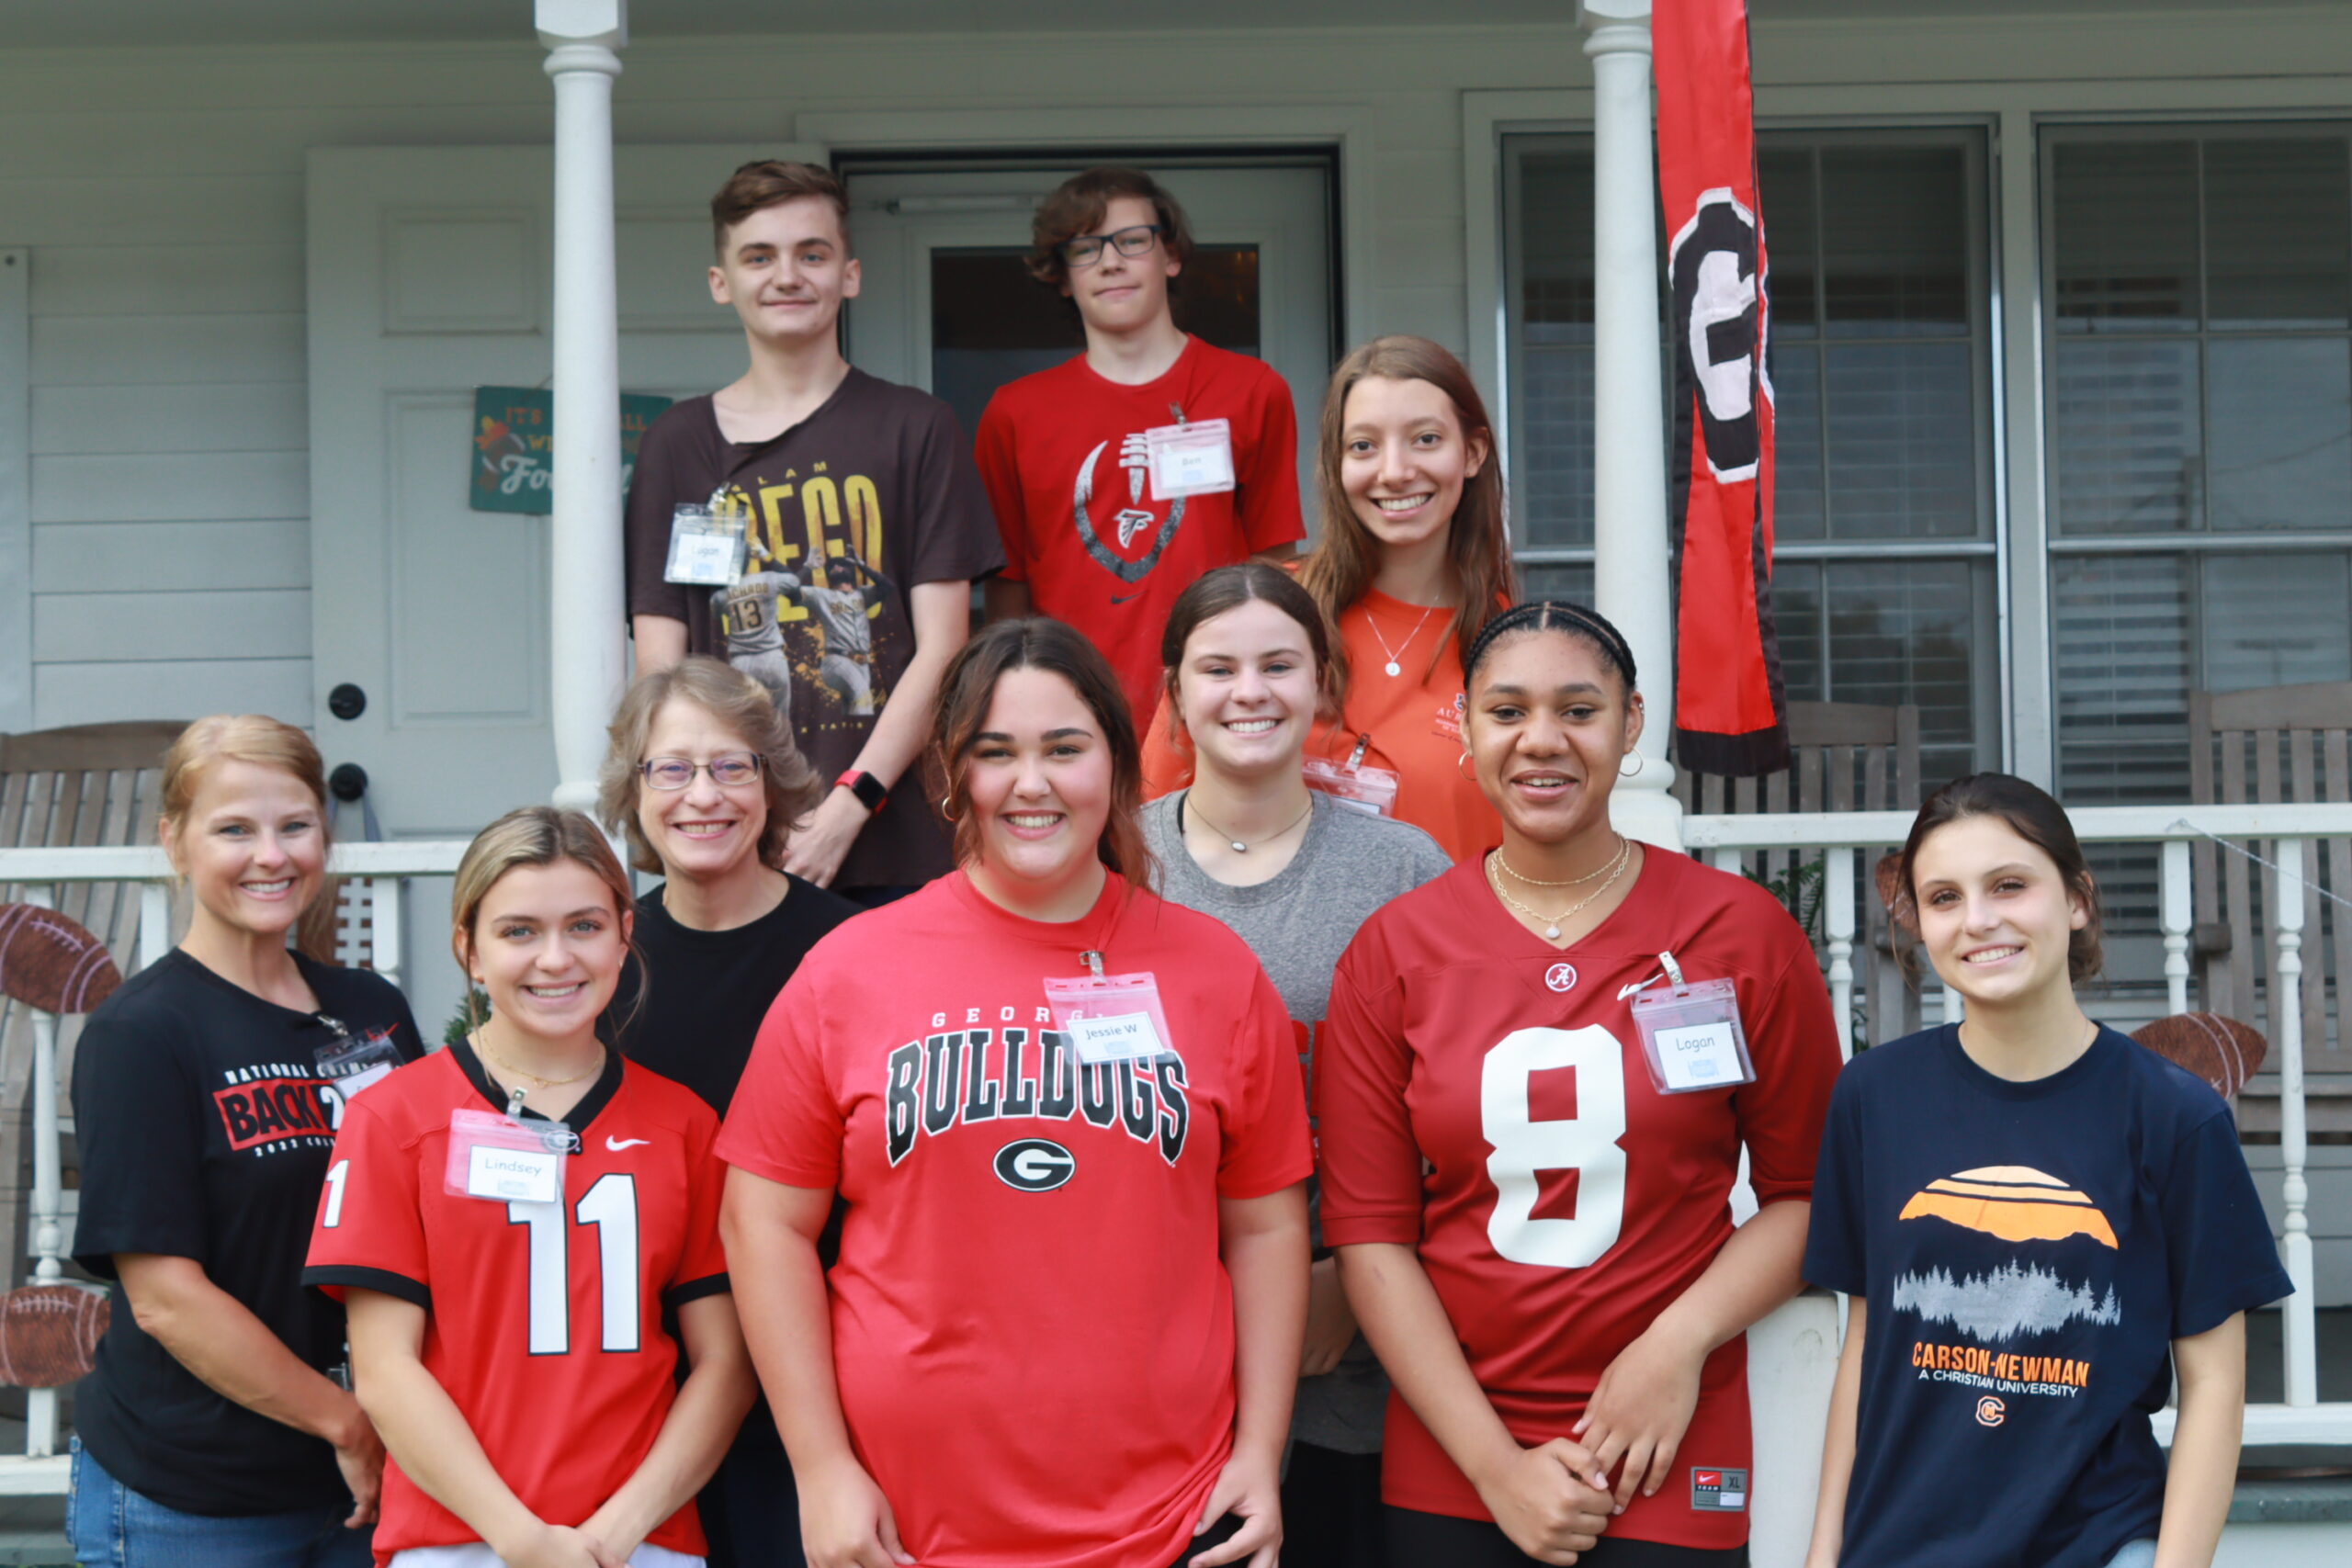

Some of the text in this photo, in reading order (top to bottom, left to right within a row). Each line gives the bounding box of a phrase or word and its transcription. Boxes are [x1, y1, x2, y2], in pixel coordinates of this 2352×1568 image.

[732, 599, 763, 631] 13
[1085, 1022, 1138, 1041] Jessie W
[1675, 1036, 1716, 1054] Logan
[224, 1063, 310, 1085] NATIONAL
[885, 1026, 1190, 1168] BULLDOGS
[220, 1085, 322, 1143] BACK
[254, 1139, 299, 1157] 2022
[1480, 1022, 1628, 1269] 8
[484, 1157, 543, 1178] Lindsey
[506, 1172, 640, 1357] 11
[1912, 1341, 2091, 1388] CARSON-NEWMAN
[1917, 1369, 2079, 1399] A CHRISTIAN UNIVERSITY
[1728, 1476, 1741, 1488] XL
